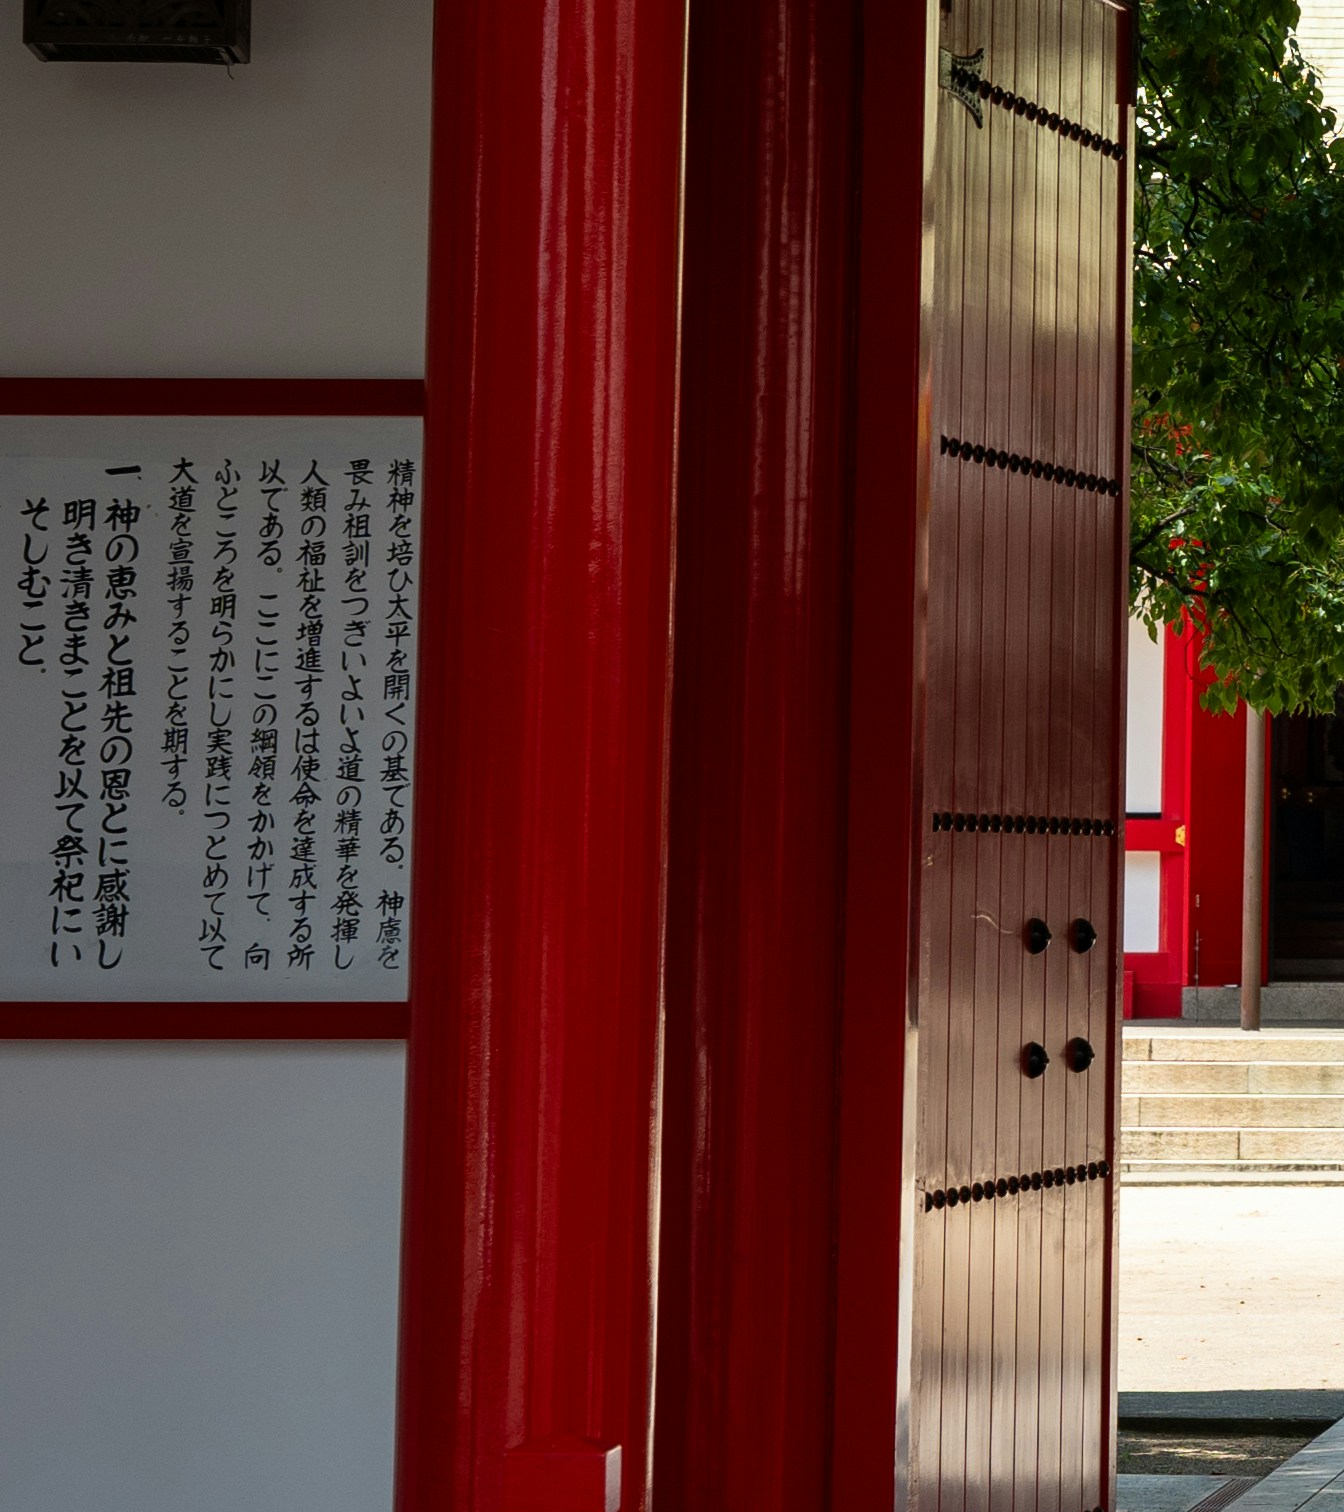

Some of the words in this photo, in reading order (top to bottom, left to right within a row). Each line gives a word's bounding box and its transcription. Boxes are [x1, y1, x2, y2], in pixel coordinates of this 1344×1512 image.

[49, 499, 96, 967] 明き清きまことを以て祭祀にい
[161, 457, 198, 815] 大道を宣揚することを期する。
[199, 459, 240, 970] ふところを明らかにし実践につとめて以て
[287, 459, 329, 970] 人類の福祉を増進するは使命を達成する所
